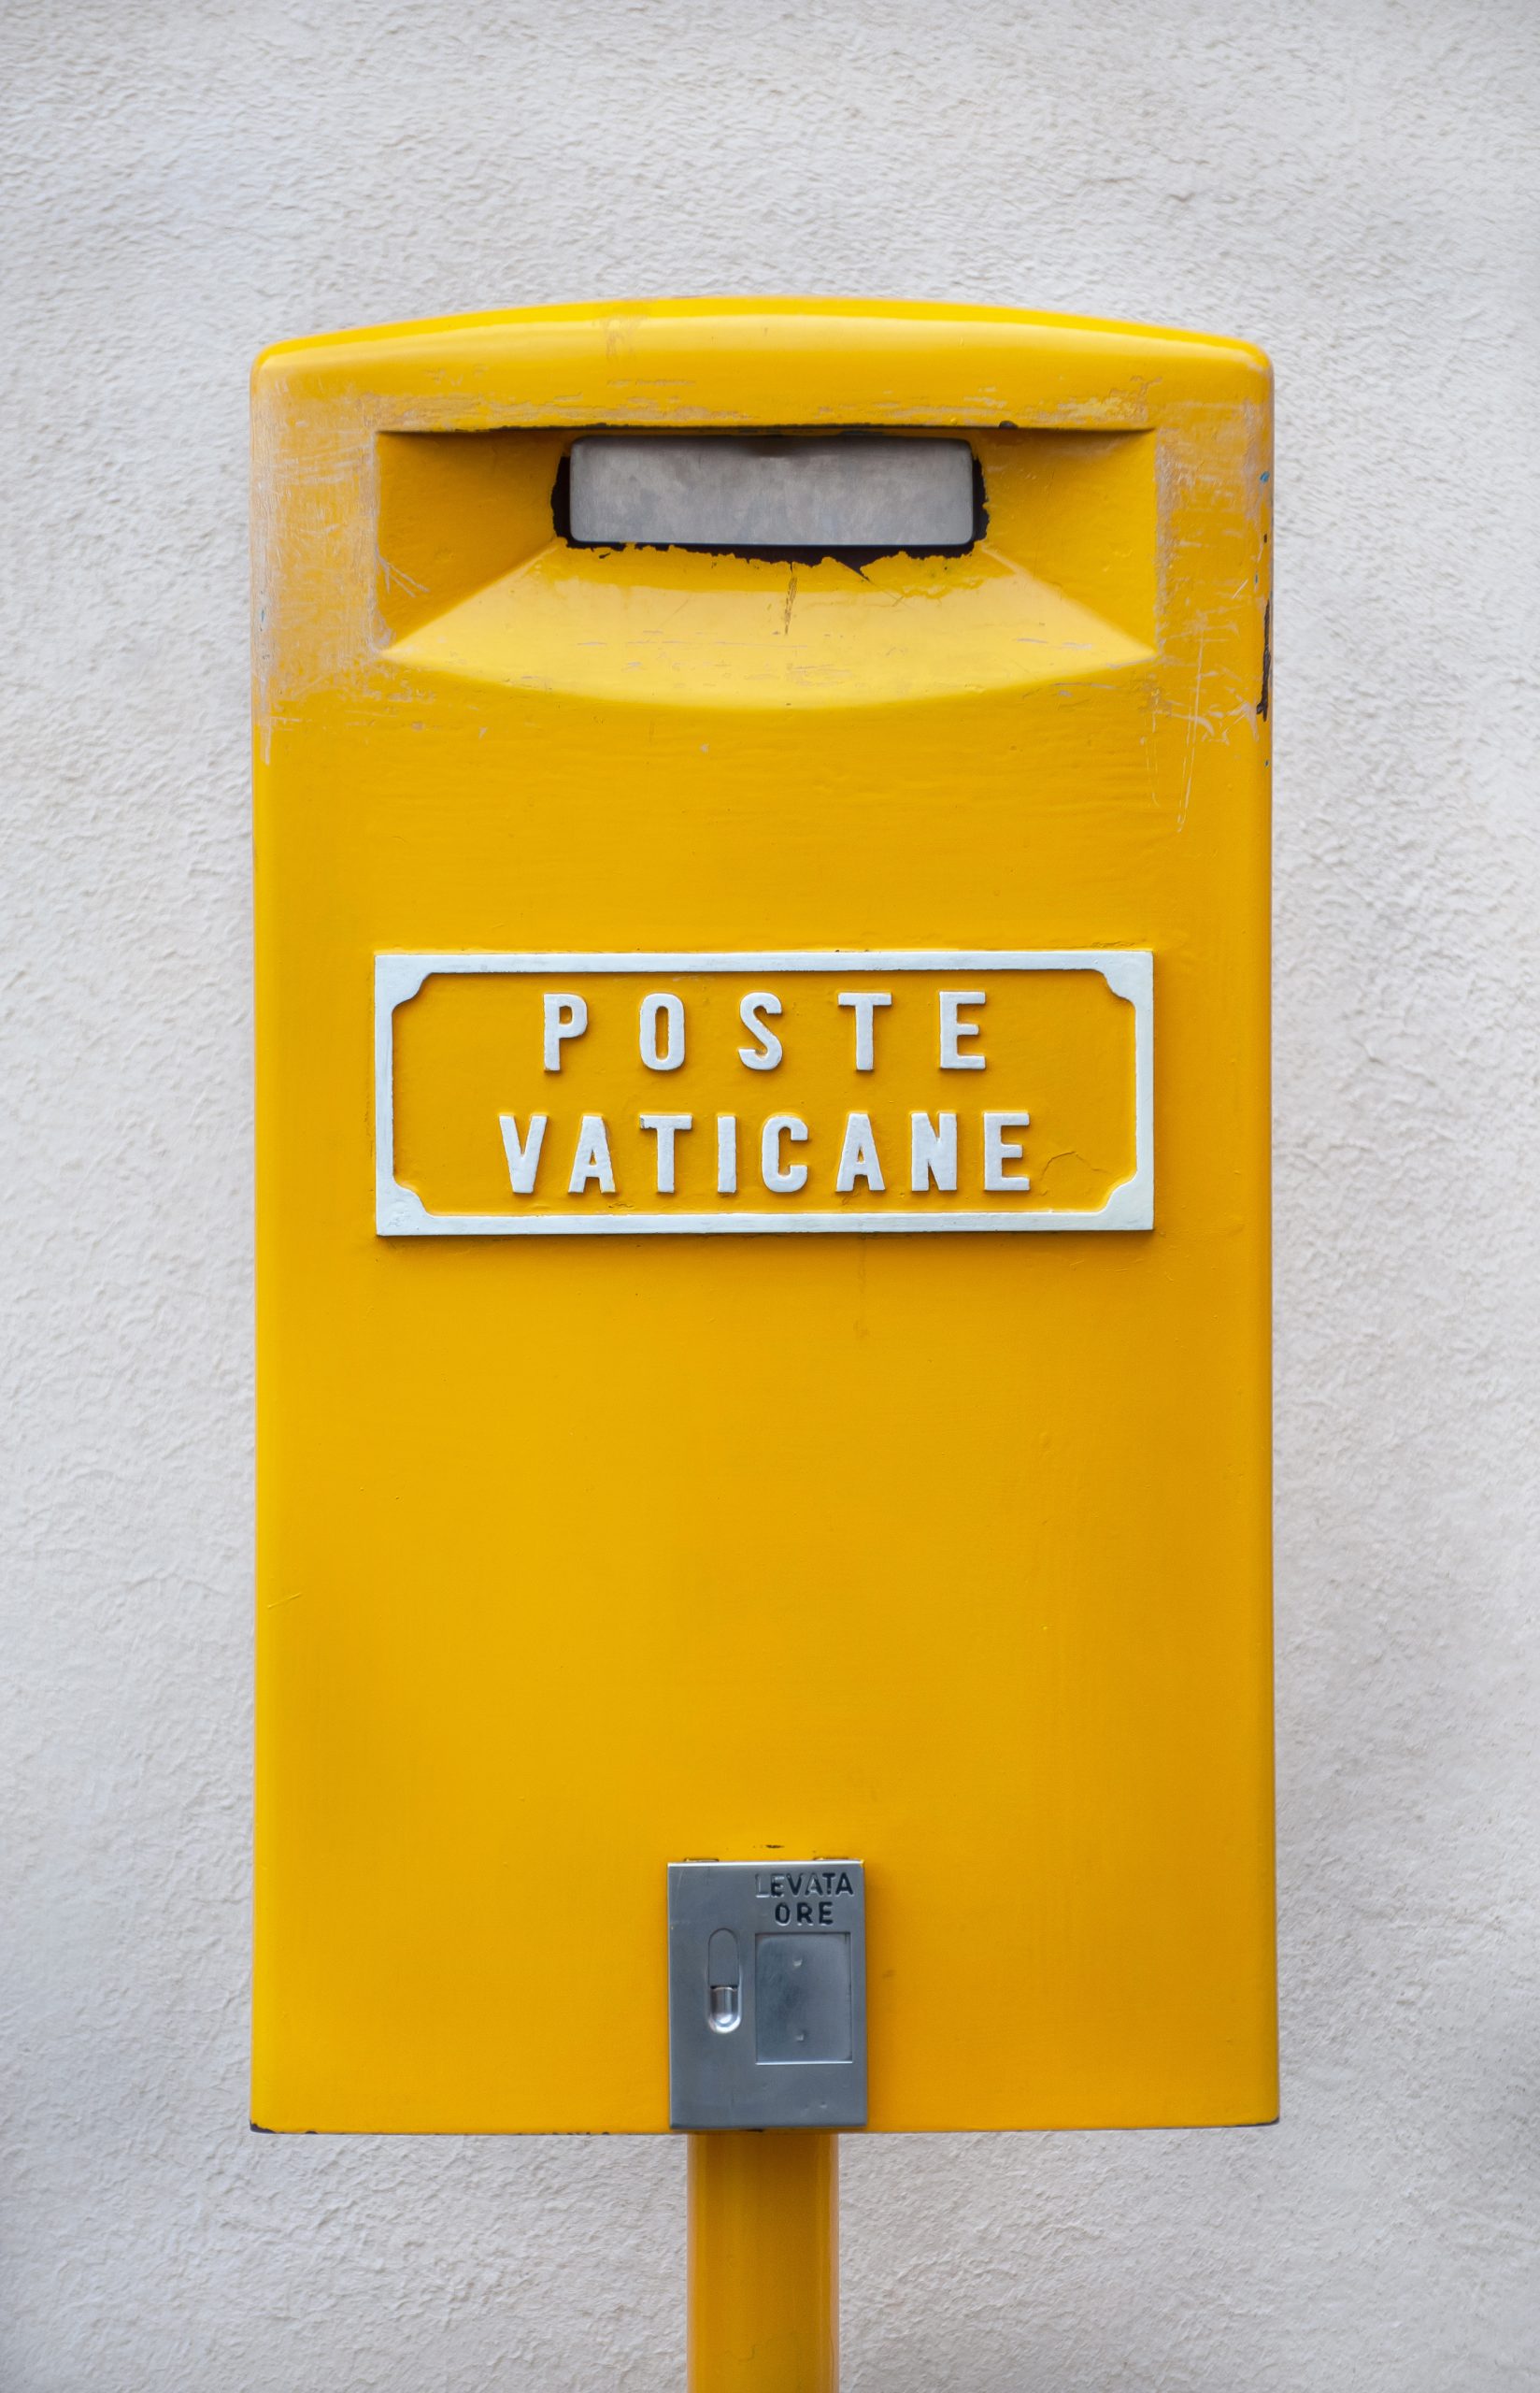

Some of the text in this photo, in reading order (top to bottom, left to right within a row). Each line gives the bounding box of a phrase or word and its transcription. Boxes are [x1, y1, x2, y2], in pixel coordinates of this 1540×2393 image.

[542, 991, 986, 1072] POSTE
[498, 1112, 1031, 1194] VATICANE
[755, 1872, 854, 1898] LEVATA
[775, 1901, 834, 1926] ORE
